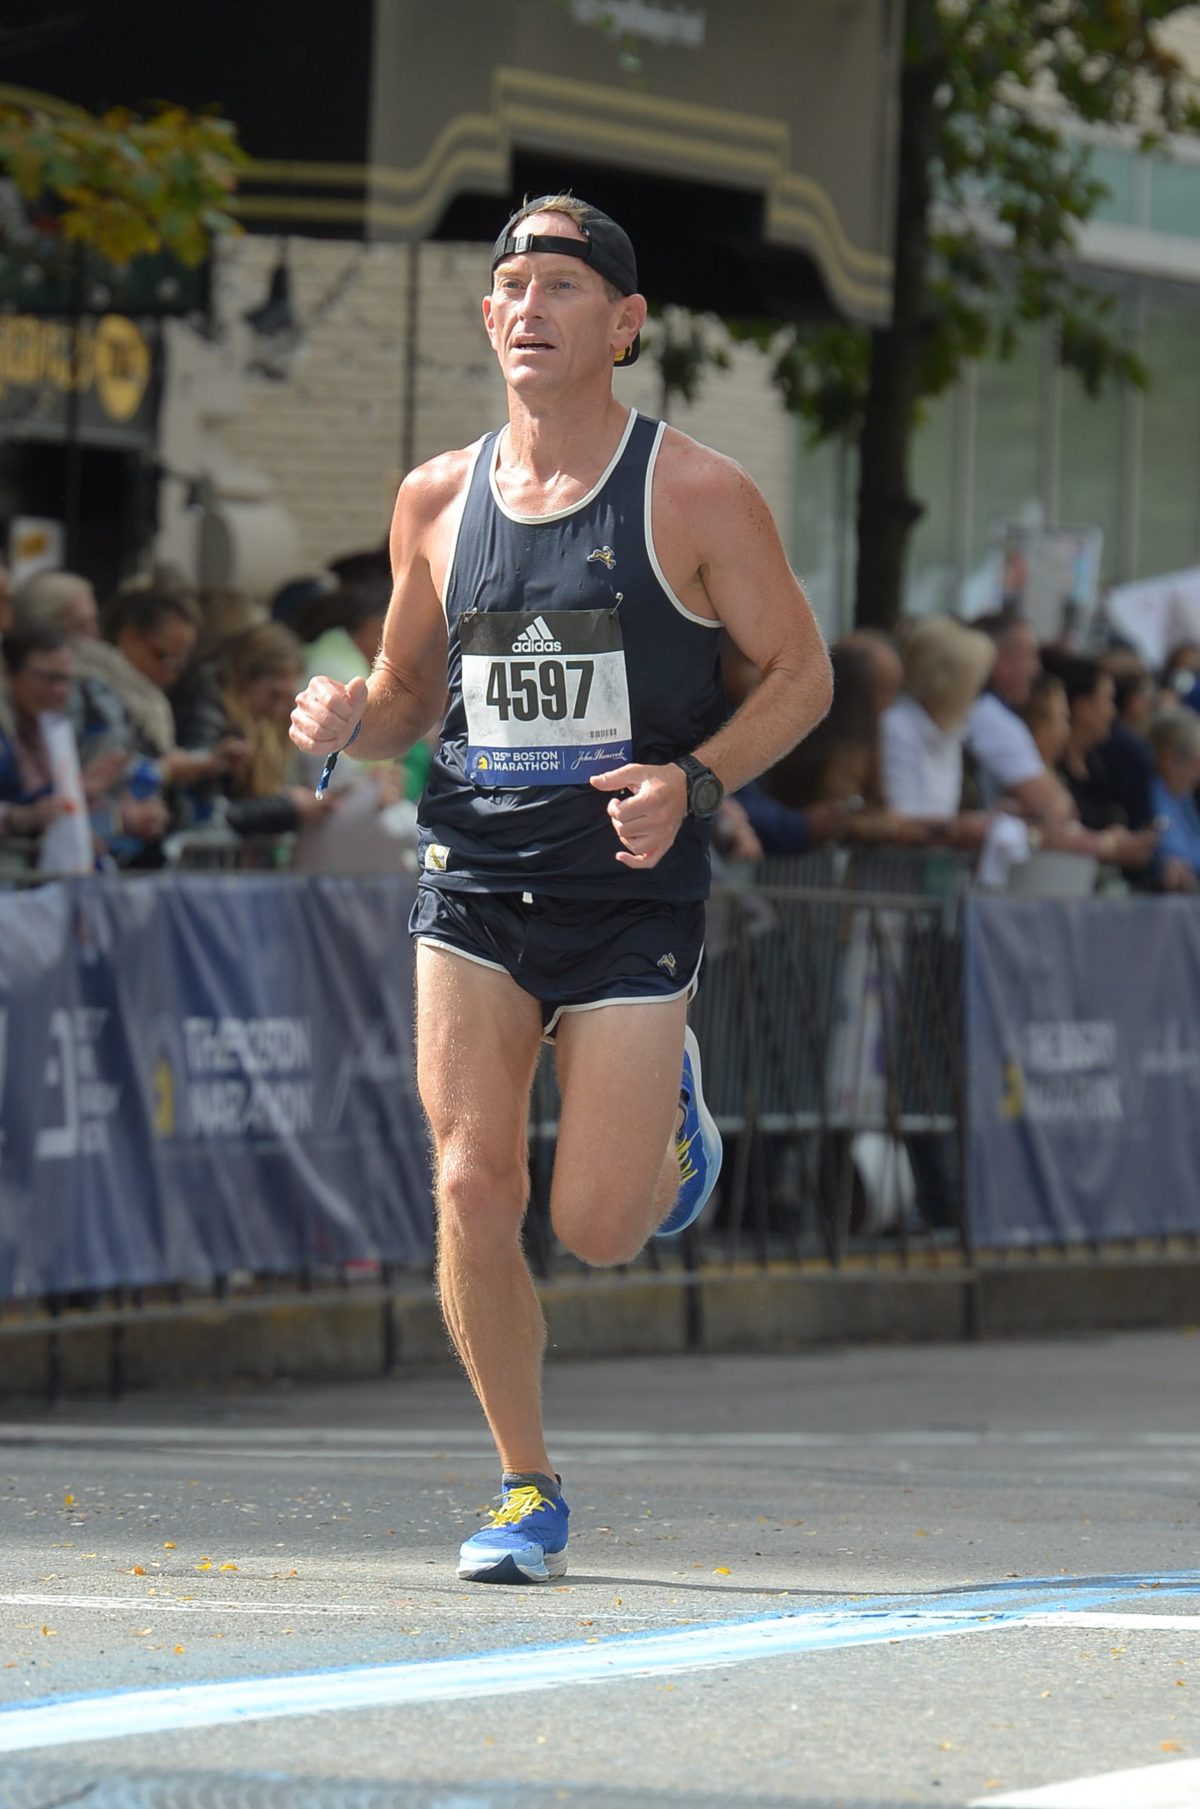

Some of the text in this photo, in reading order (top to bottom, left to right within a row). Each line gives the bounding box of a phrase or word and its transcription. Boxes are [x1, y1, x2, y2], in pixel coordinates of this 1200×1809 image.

[512, 639, 562, 652] adidas
[486, 660, 594, 721] 4597
[513, 751, 558, 762] BOSTON
[570, 750, 593, 770] John
[494, 761, 559, 771] MARATHON
